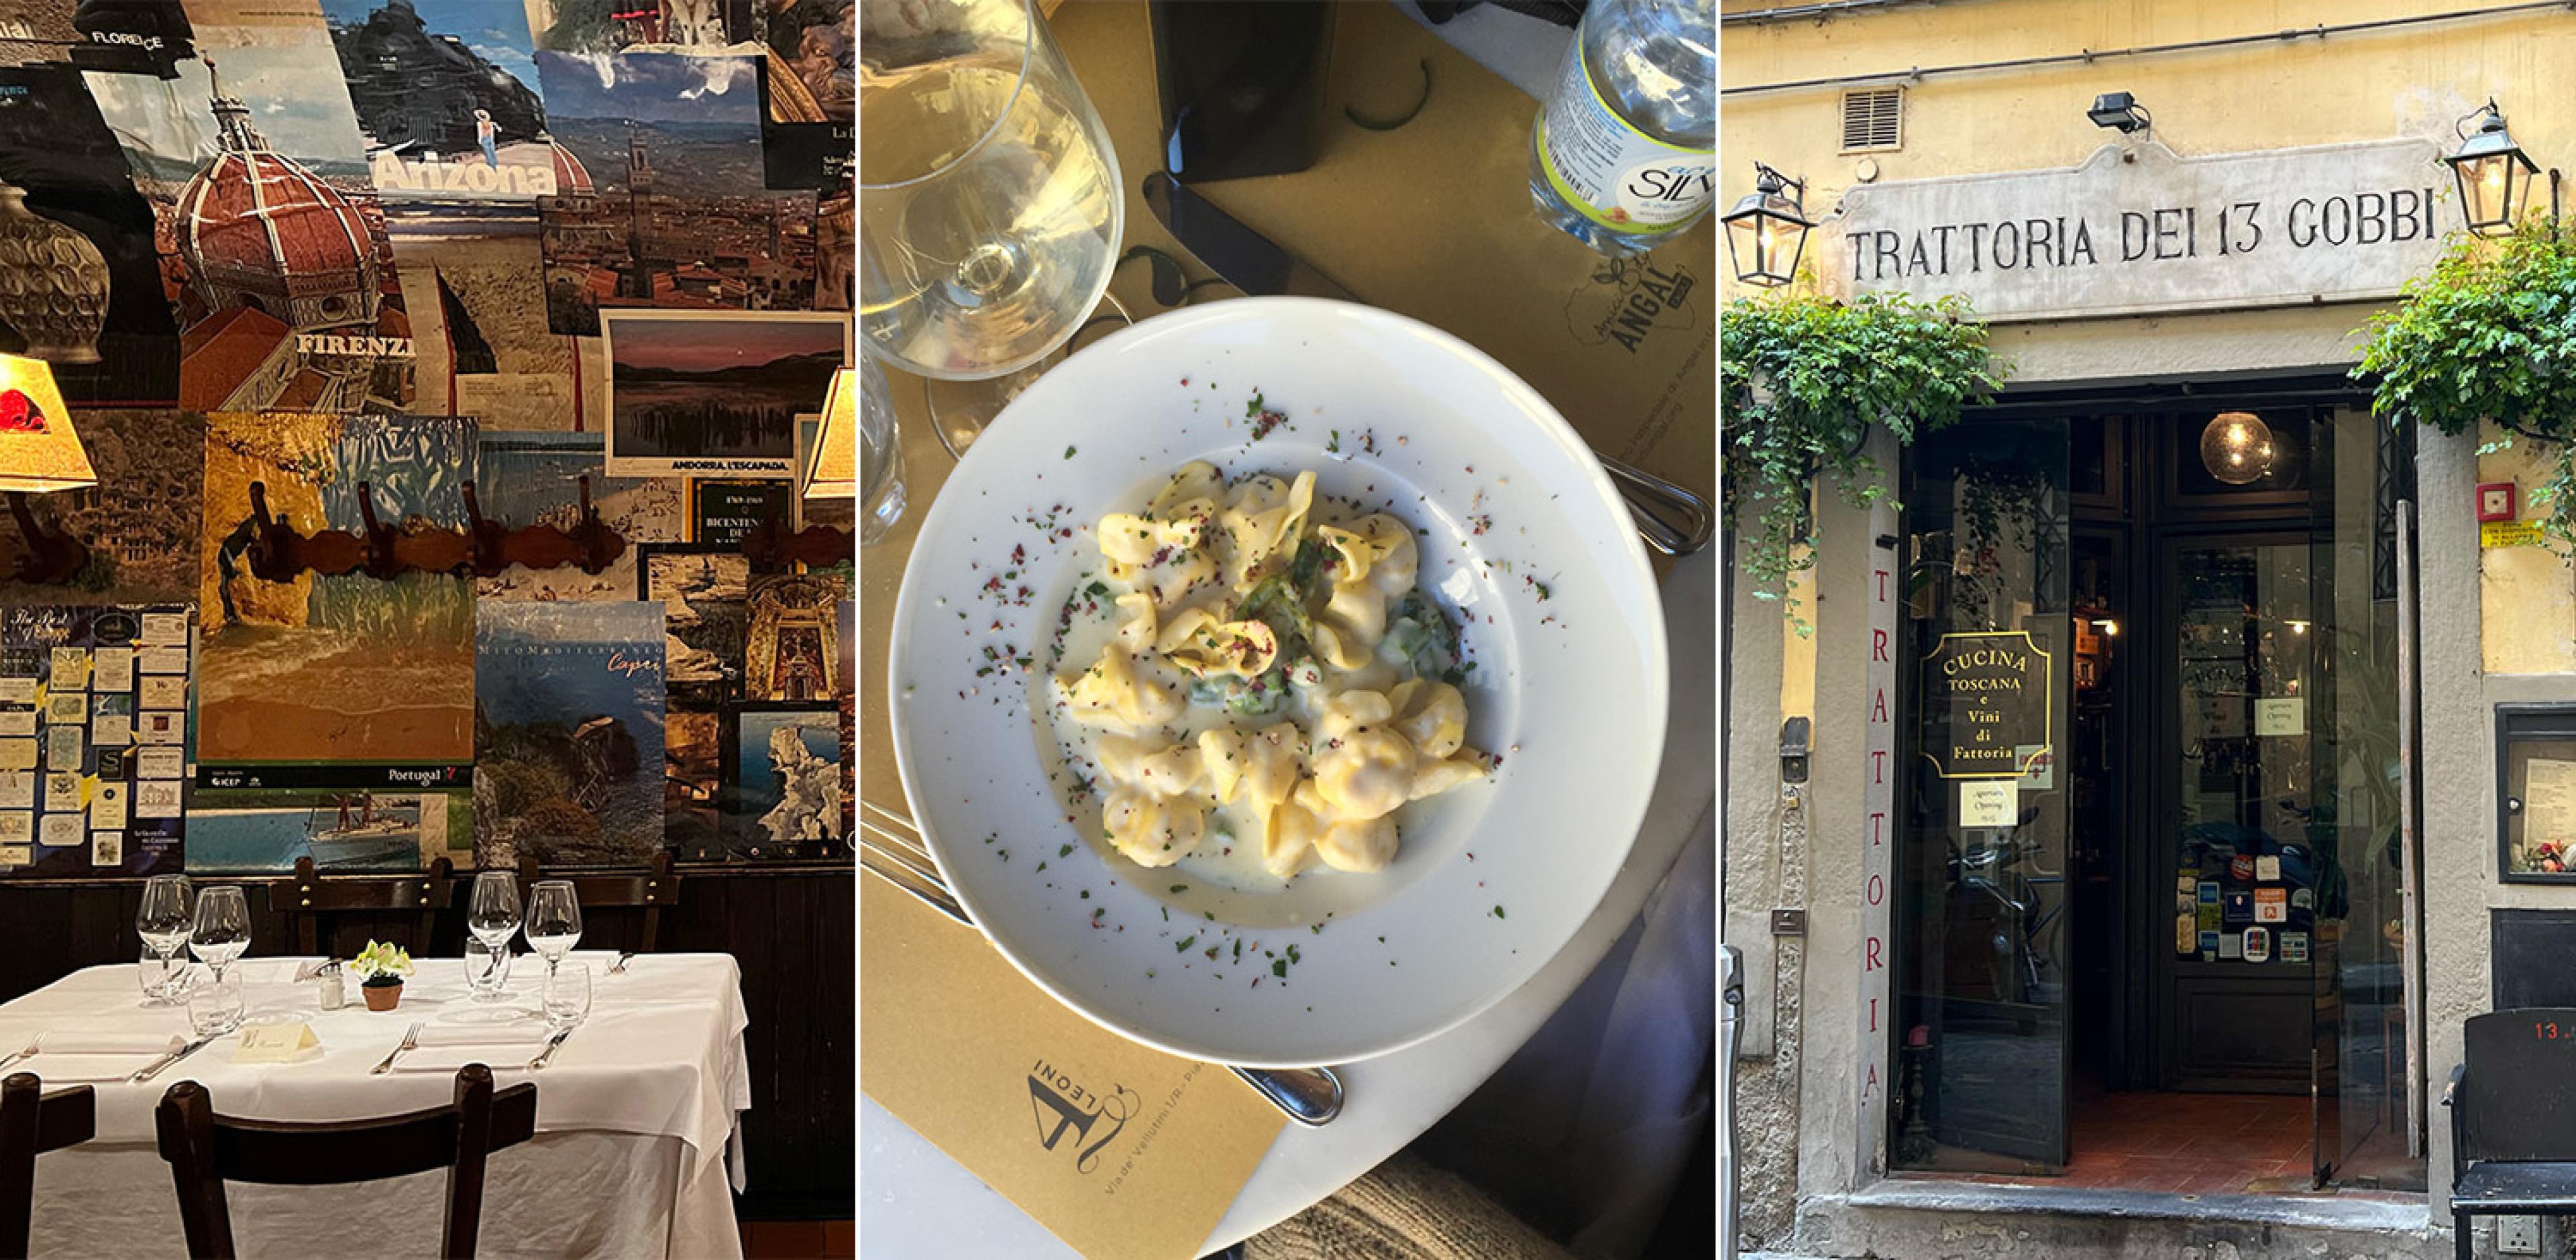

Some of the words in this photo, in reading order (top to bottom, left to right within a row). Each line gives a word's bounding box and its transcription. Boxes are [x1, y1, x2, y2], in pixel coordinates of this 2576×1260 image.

[373, 149, 556, 194] Arizona
[1846, 216, 2098, 280] TRATTORIA
[2120, 207, 2196, 262] DEI
[2218, 202, 2263, 257] 13
[2288, 186, 2435, 248] GOBBI
[1611, 268, 1681, 355] ANGAL
[1943, 650, 2027, 675] CUCINA
[1948, 677, 2021, 691] TOSCANA
[1980, 696, 1988, 705] e
[1968, 710, 2000, 722] Vini
[1976, 729, 1991, 741] di
[1953, 746, 2012, 759] Fattoria
[388, 768, 441, 786] Portugal
[1864, 569, 1889, 1098] TRATTORIA
[1033, 1058, 1097, 1110] LEONI
[1027, 1074, 1104, 1151] 4
[1106, 1176, 1123, 1194] Via
